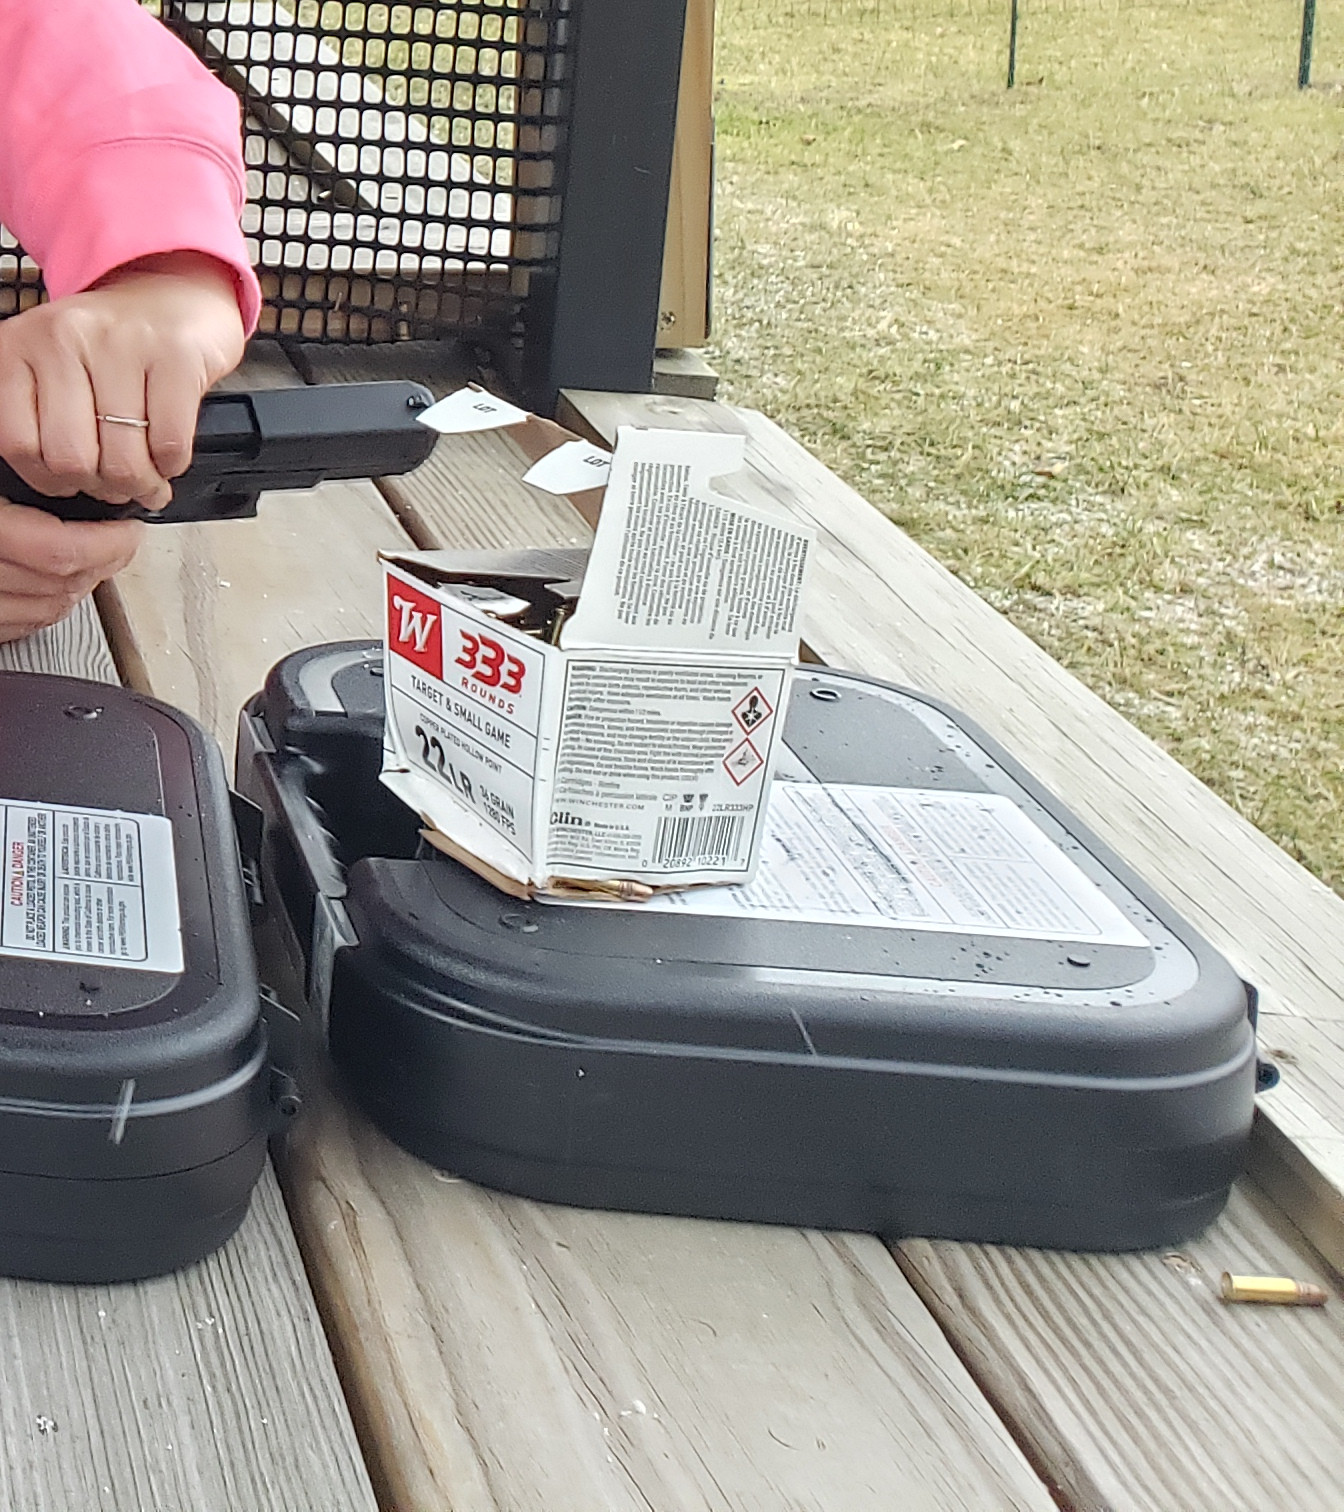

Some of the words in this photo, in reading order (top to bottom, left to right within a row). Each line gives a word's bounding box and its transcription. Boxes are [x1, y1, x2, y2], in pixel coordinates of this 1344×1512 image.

[472, 403, 497, 414] LOT
[582, 455, 611, 468] LOT
[393, 594, 438, 653] W
[454, 628, 526, 695] 333
[461, 676, 516, 715] ROUNDS
[410, 674, 444, 704] TARGET
[445, 698, 452, 712] &
[454, 702, 483, 732] SMALL
[485, 721, 511, 749] GAME
[490, 792, 515, 819] GRAIN
[500, 814, 517, 836] FPS
[11, 841, 25, 872] DANGER
[641, 859, 648, 868] 0
[697, 856, 726, 867] 10221
[10, 877, 24, 907] CAUTION
